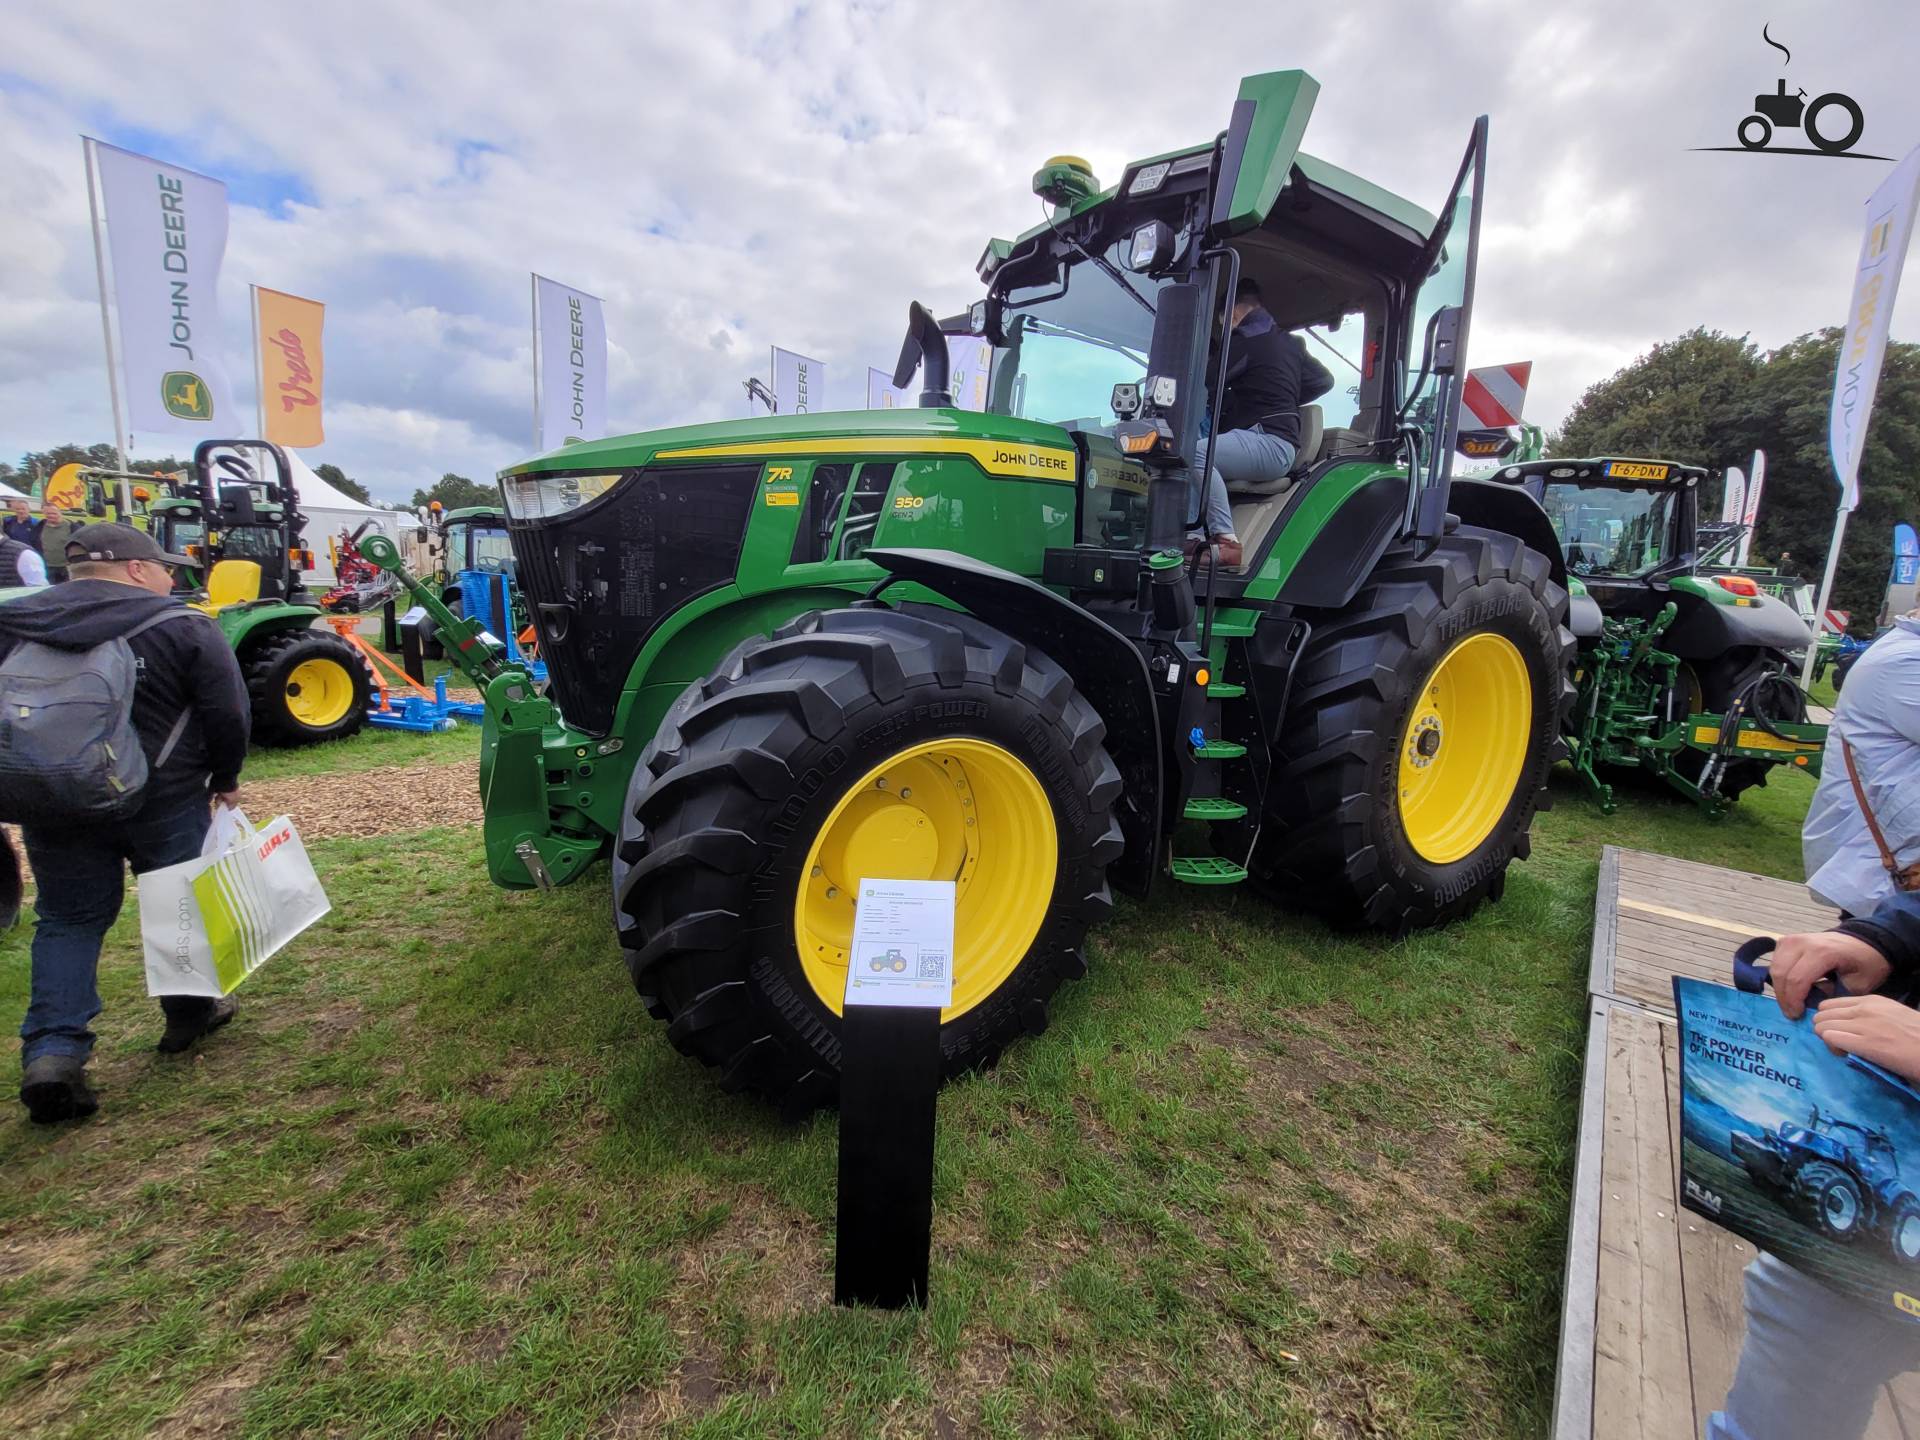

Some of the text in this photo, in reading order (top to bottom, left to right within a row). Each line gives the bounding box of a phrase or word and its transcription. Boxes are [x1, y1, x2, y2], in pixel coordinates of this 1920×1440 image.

[157, 173, 194, 362] JOHN DEERE
[268, 328, 319, 414] Vredo
[568, 295, 585, 431] JOHN DEERE
[991, 449, 1068, 471] JOHN DEERE
[1614, 464, 1665, 478] T-67-DNX
[766, 466, 794, 485] 7R
[893, 496, 925, 510] 350
[912, 700, 991, 723] POWER
[175, 896, 195, 975] claas.com
[1688, 1009, 1708, 1020] NEW
[1717, 1018, 1753, 1034] HEAVY
[1755, 1028, 1790, 1045] DUTY
[1689, 1030, 1766, 1065] THE POWER
[1689, 1041, 1701, 1055] OF
